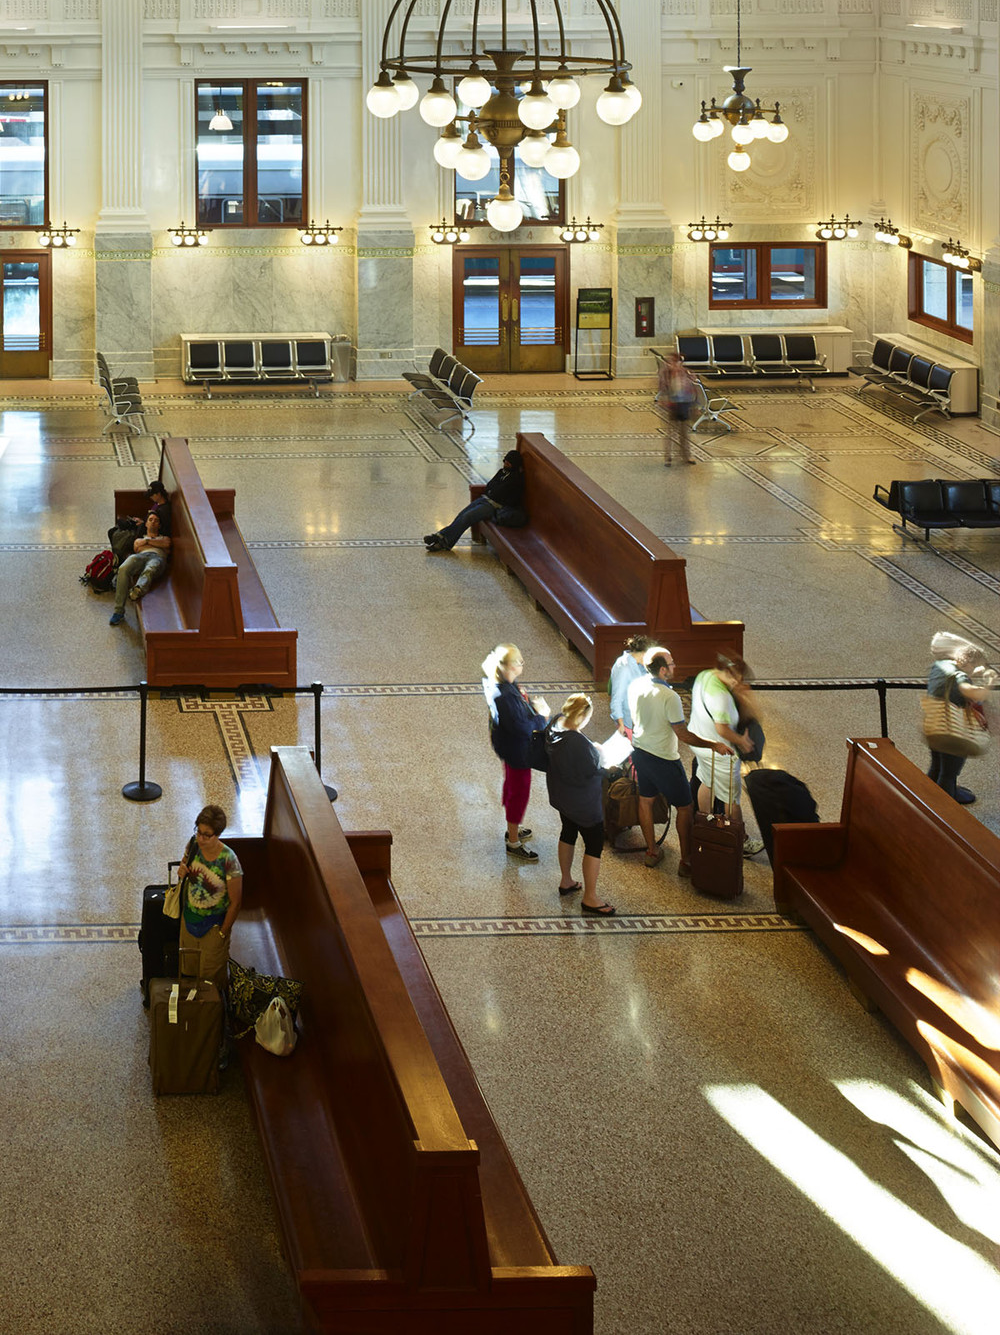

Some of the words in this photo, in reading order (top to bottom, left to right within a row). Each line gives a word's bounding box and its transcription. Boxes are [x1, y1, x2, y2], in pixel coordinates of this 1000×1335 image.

[8, 235, 15, 246] 3
[488, 230, 521, 241] GATE
[526, 230, 533, 240] 4
